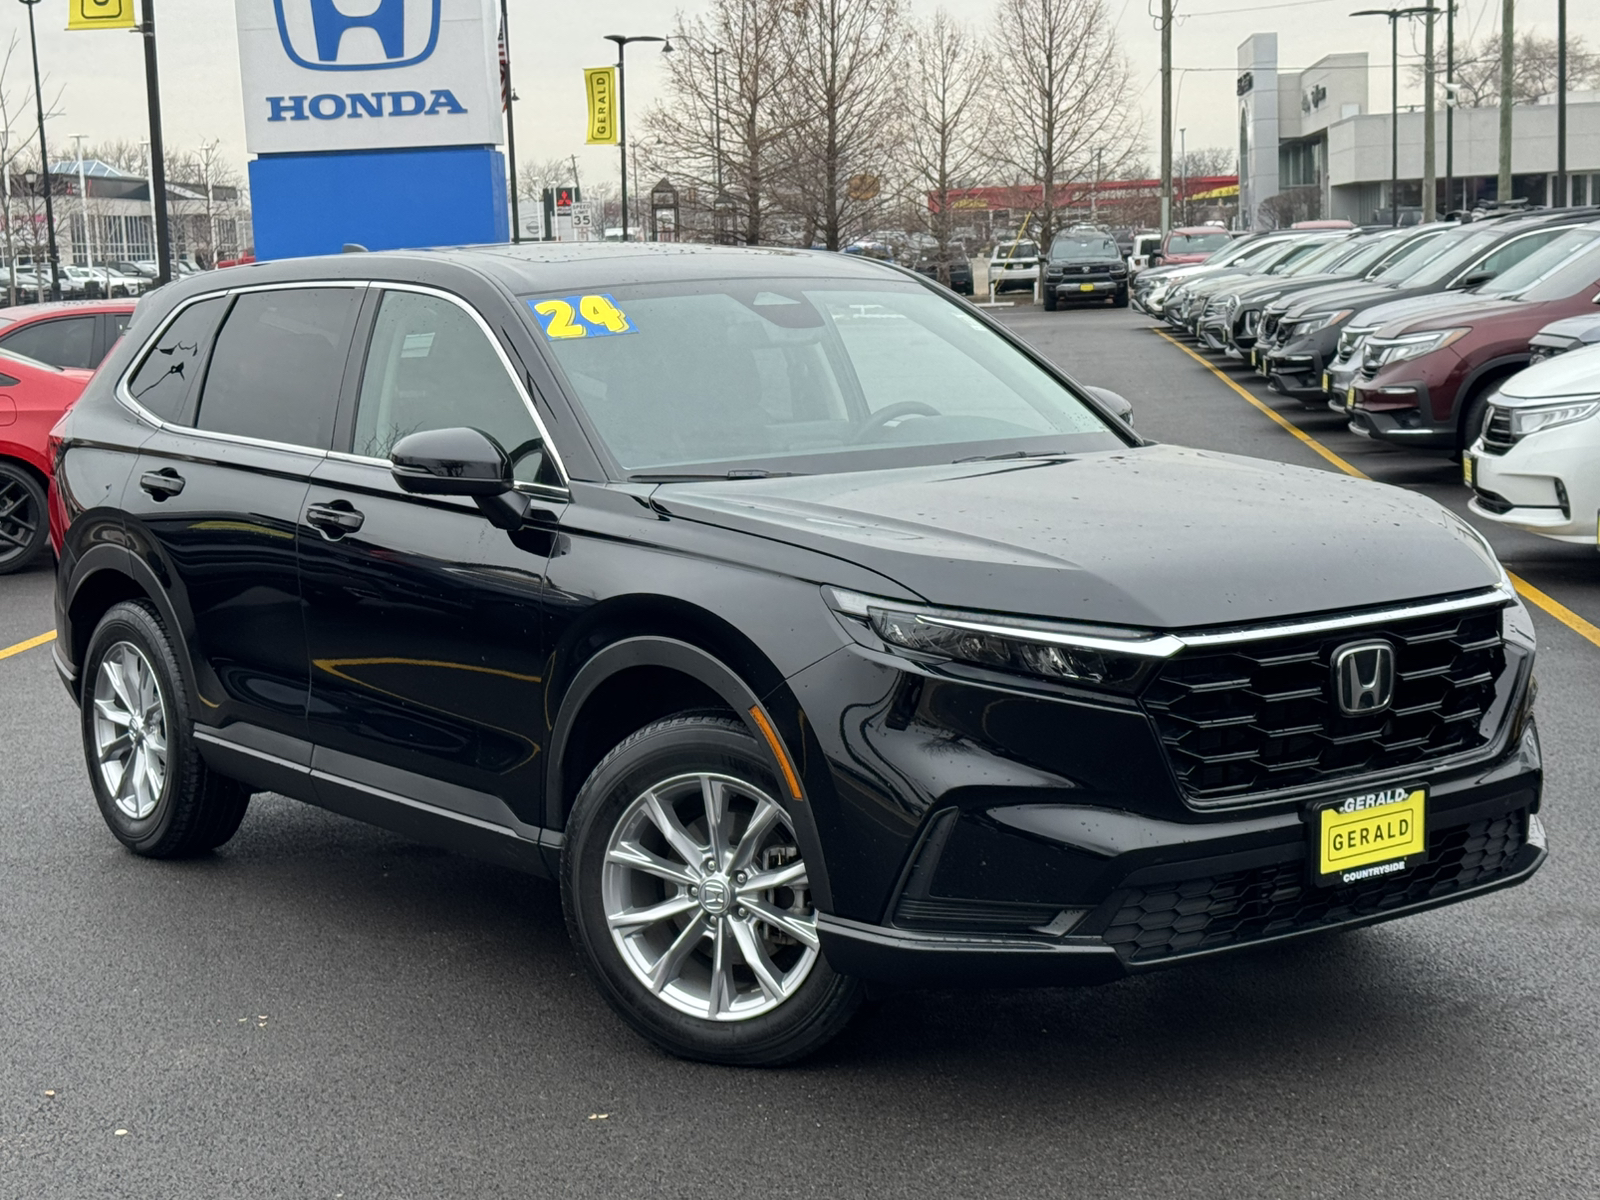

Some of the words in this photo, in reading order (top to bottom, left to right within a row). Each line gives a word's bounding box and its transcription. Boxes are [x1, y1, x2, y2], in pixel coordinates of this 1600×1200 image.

[265, 89, 468, 122] HONDA
[596, 77, 606, 134] GERALD
[574, 215, 590, 225] 35
[534, 295, 630, 338] 24
[1333, 819, 1409, 851] GERALD
[1343, 861, 1406, 883] COUNTRYSIDE
